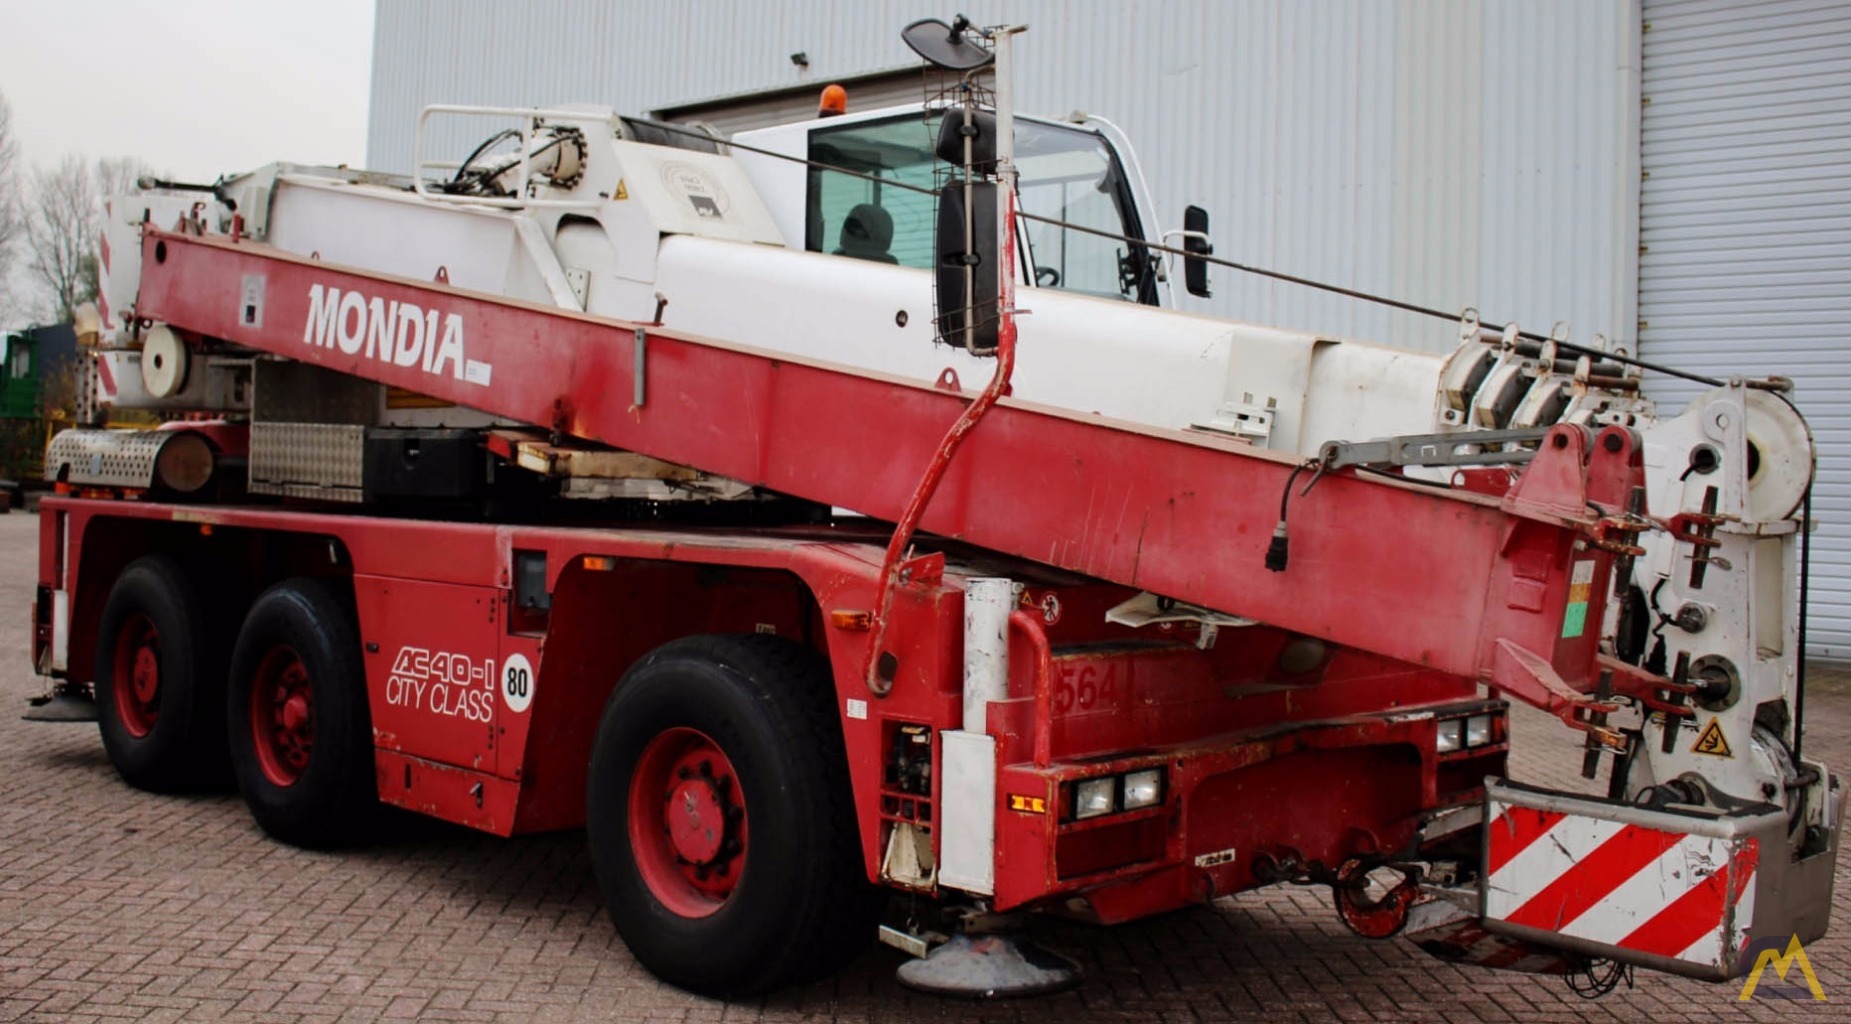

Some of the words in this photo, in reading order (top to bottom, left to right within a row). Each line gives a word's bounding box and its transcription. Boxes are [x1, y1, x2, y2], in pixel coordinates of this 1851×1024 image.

[303, 283, 464, 381] MONDIA
[386, 675, 427, 709] CITY
[430, 683, 494, 723] CLASS
[507, 667, 528, 698] 80
